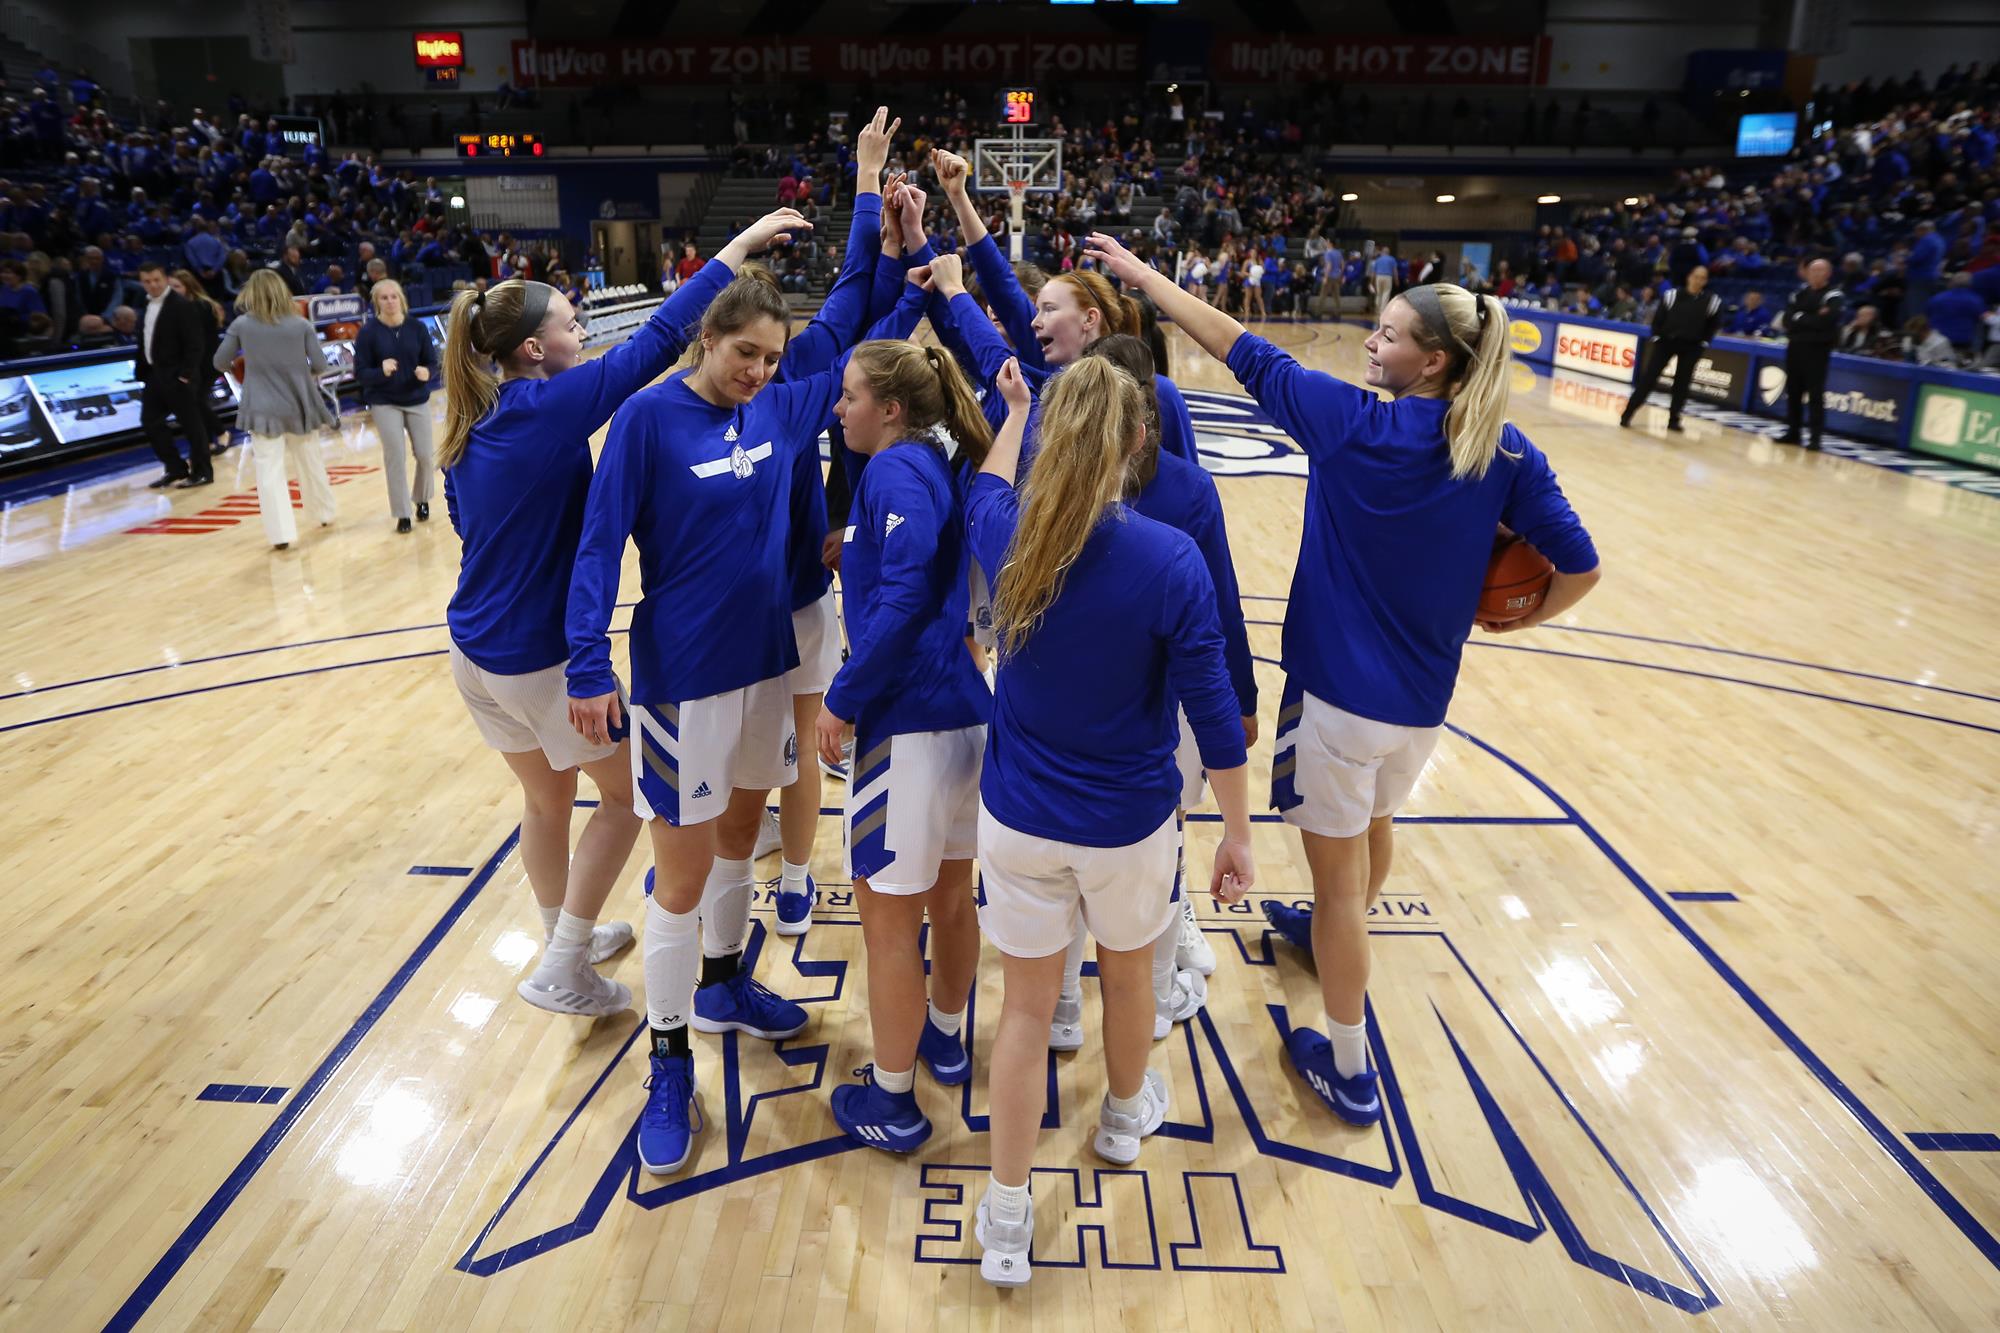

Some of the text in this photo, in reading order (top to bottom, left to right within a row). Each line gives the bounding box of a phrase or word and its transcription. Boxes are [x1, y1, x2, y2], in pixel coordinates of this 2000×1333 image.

[621, 47, 696, 76] HOT
[709, 45, 812, 73] ZONE
[942, 43, 1020, 72] HOT
[1033, 43, 1137, 72] ZONE
[1334, 44, 1414, 73] HOT
[1425, 45, 1530, 74] ZONE
[1007, 102, 1030, 122] 30
[1559, 336, 1636, 368] SCHEELS
[915, 1163, 1284, 1273] THE
